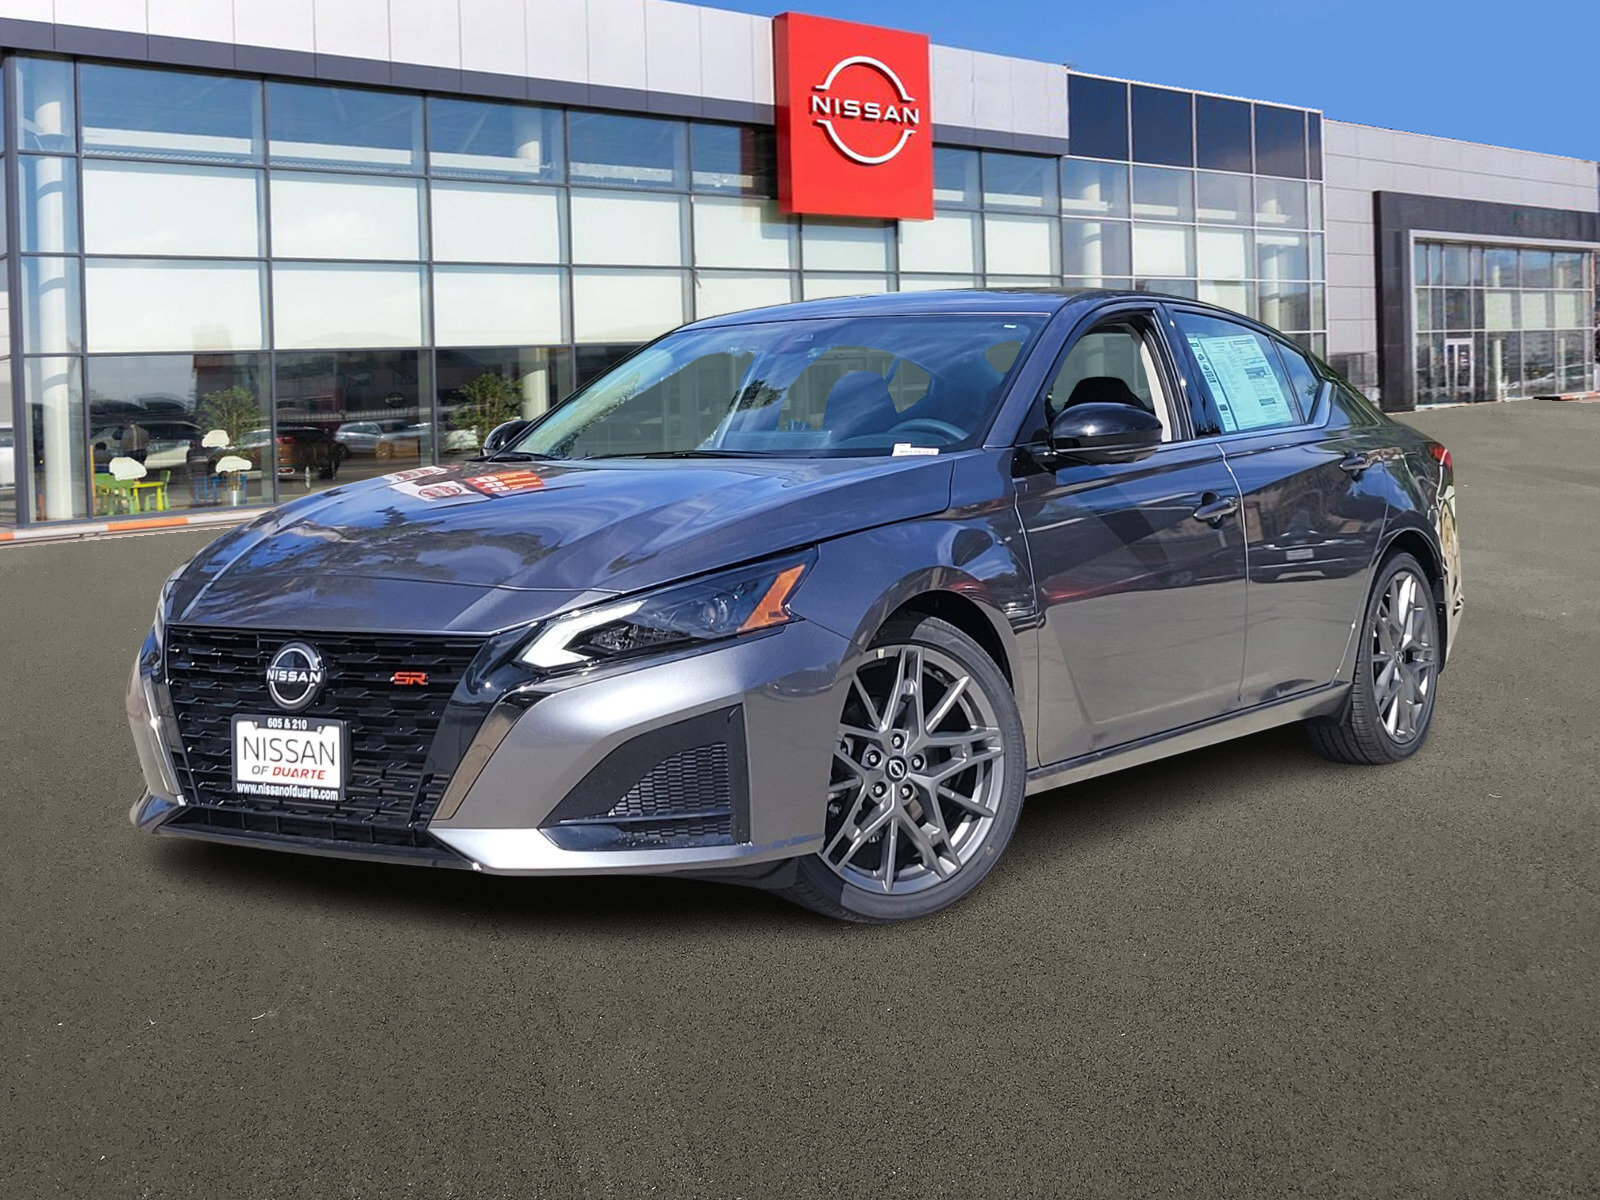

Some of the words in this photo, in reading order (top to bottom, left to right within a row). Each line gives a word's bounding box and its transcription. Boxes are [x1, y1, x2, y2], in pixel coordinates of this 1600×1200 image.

[811, 94, 920, 124] NISSAN
[266, 668, 321, 683] NISSAN
[393, 671, 428, 685] SR
[267, 717, 283, 729] 605
[284, 718, 291, 729] &
[292, 719, 308, 731] 210
[243, 736, 335, 767] NISSAN
[251, 765, 269, 776] OF
[272, 766, 327, 781] DUARTE
[236, 782, 339, 801] www.nissanofduarte.com
